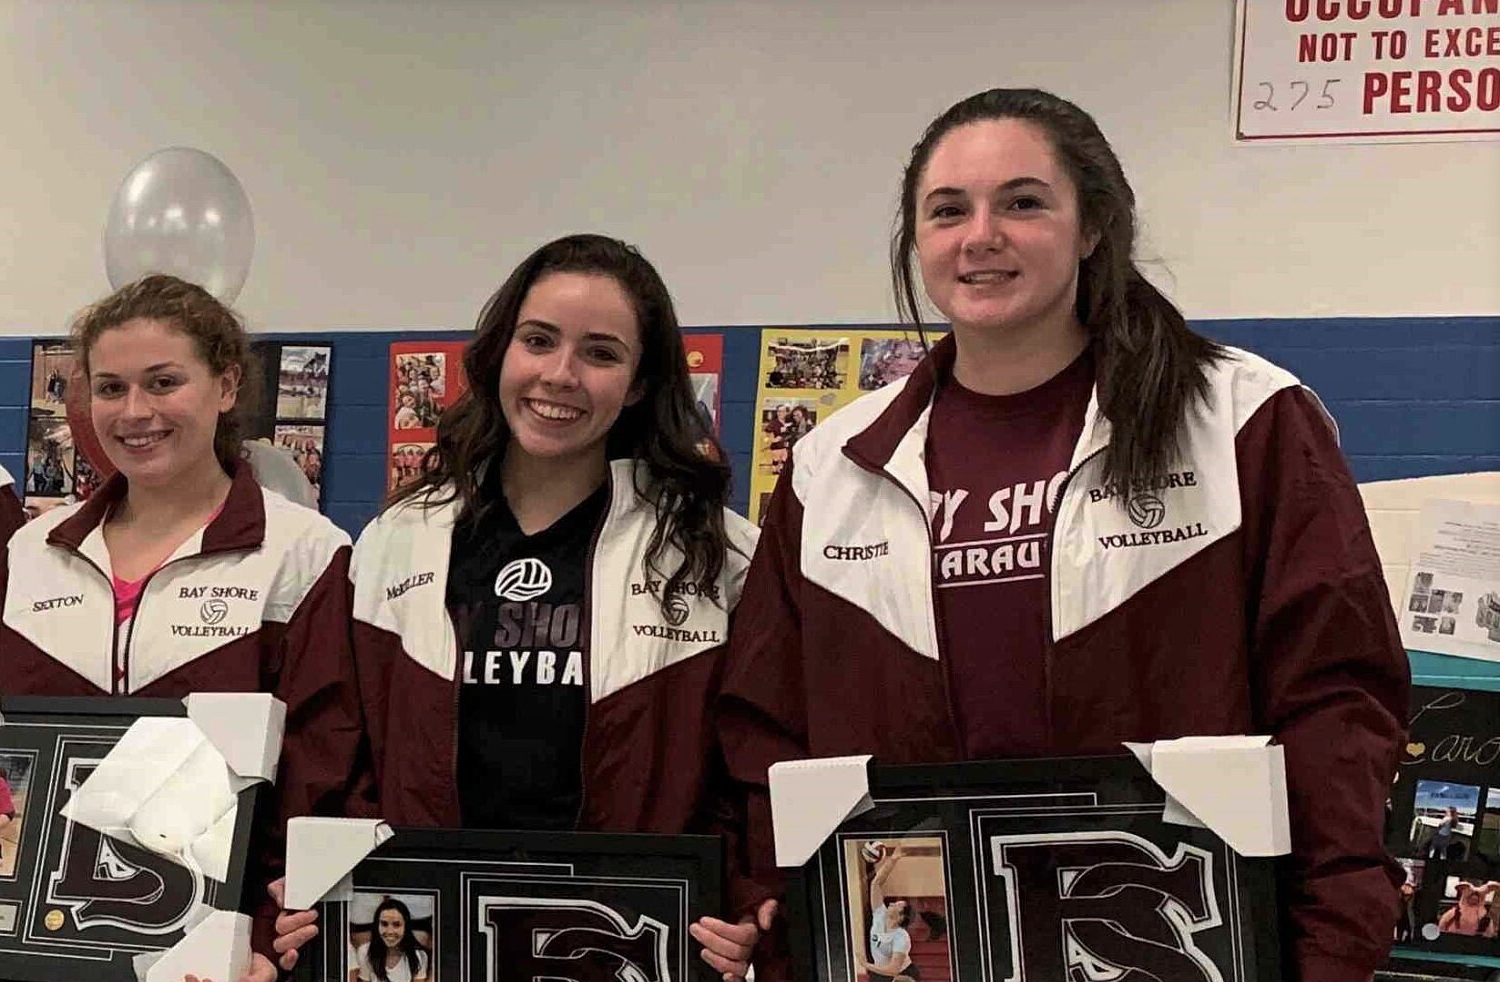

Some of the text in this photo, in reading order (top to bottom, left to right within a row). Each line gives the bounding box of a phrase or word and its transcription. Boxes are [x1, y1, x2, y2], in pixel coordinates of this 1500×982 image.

[1299, 33, 1357, 62] NOT
[1371, 30, 1407, 60] TO
[1253, 79, 1341, 111] 275
[1363, 67, 1500, 115] PERSO
[1099, 523, 1209, 549] VOLLEYBALL
[179, 586, 259, 601] BAY SHORE
[631, 581, 662, 596] BAY
[171, 624, 250, 637] VOLLEYBALL
[494, 601, 581, 649] SHO
[632, 625, 720, 643] VOLLEYBALL
[463, 650, 584, 686] LEYBA
